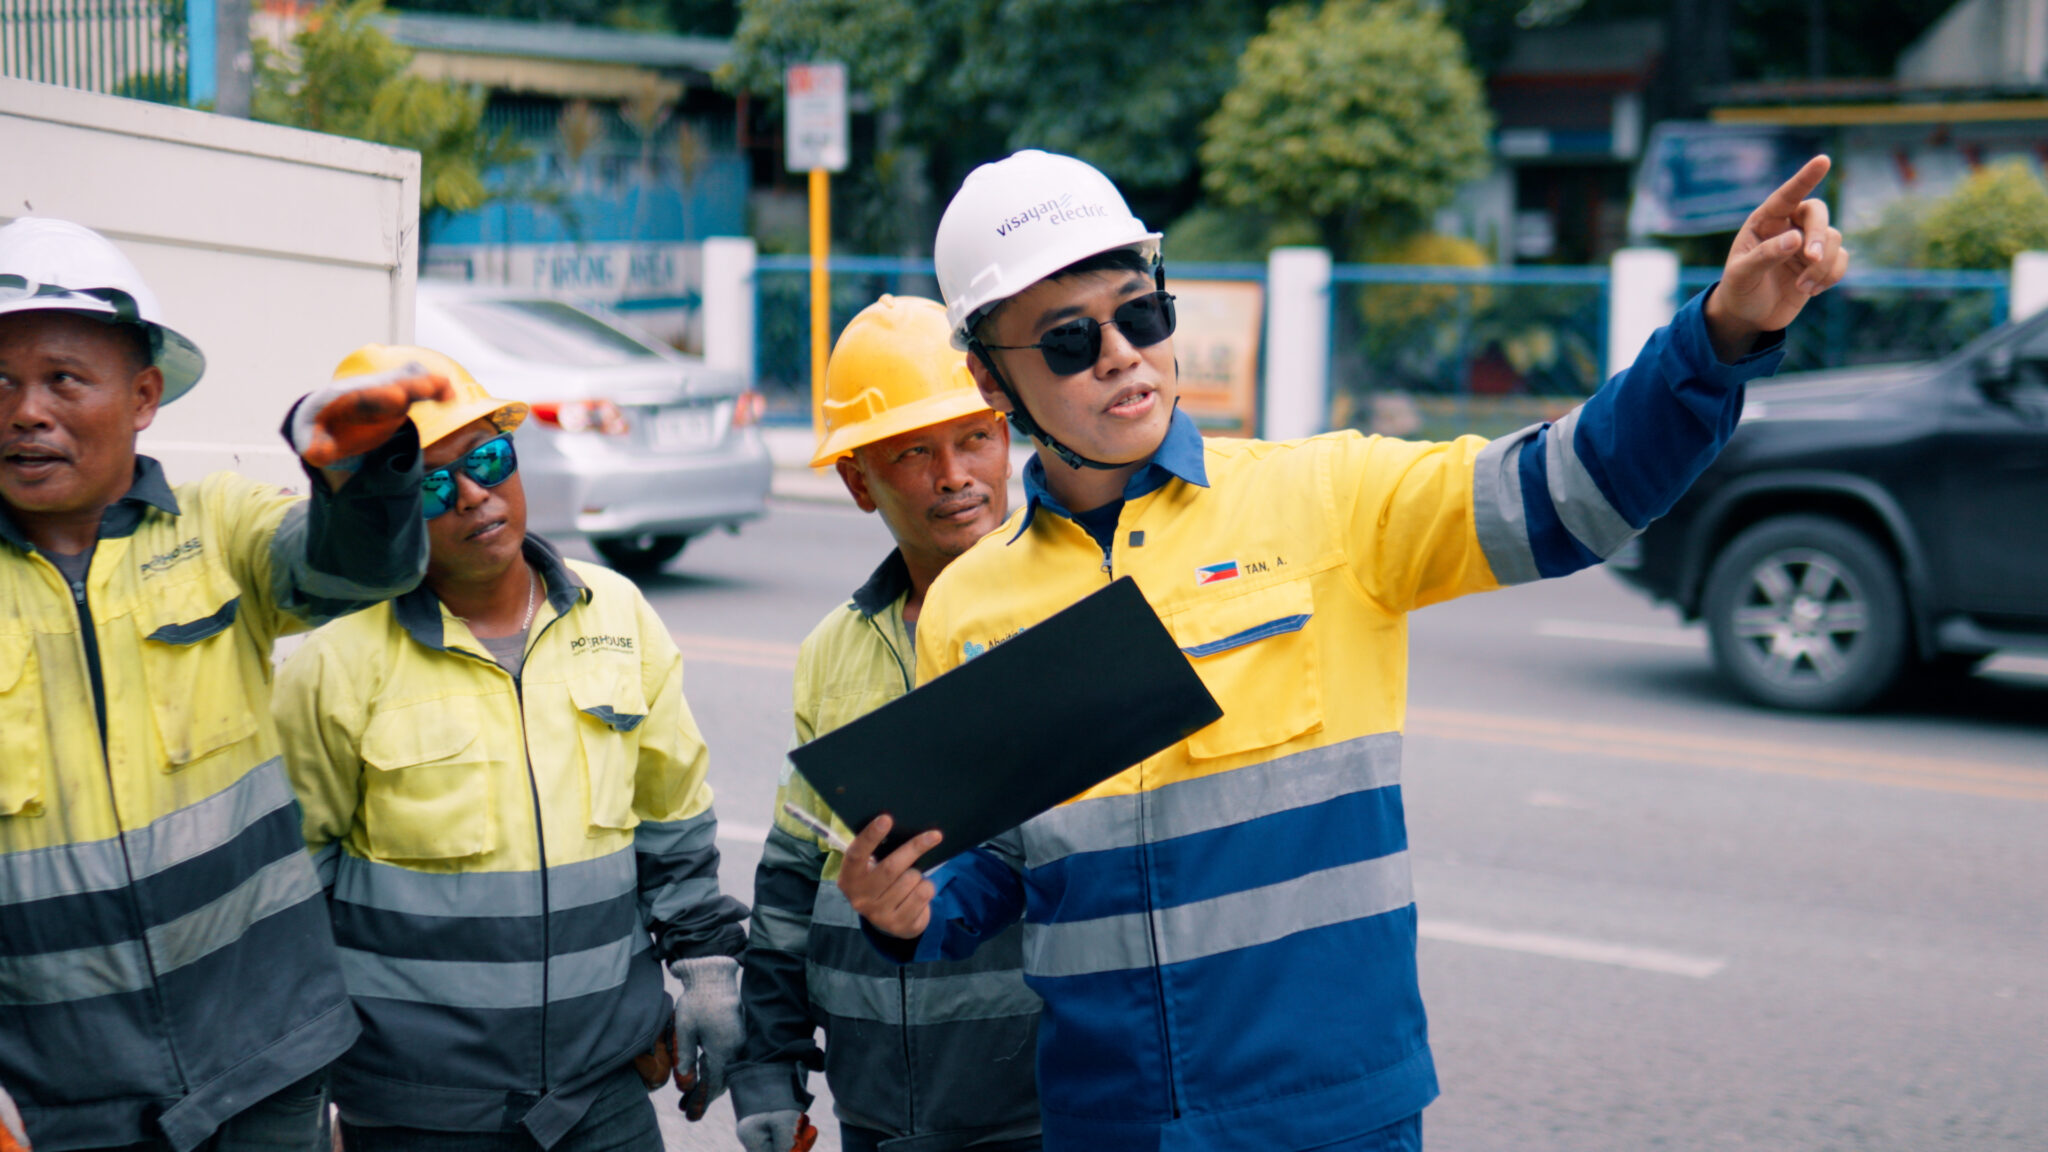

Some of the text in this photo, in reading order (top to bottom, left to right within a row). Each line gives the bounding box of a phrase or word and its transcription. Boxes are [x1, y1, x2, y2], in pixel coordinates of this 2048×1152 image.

[996, 199, 1059, 237] visayan
[1050, 203, 1108, 225] electric
[1245, 556, 1288, 575] TAN, A.
